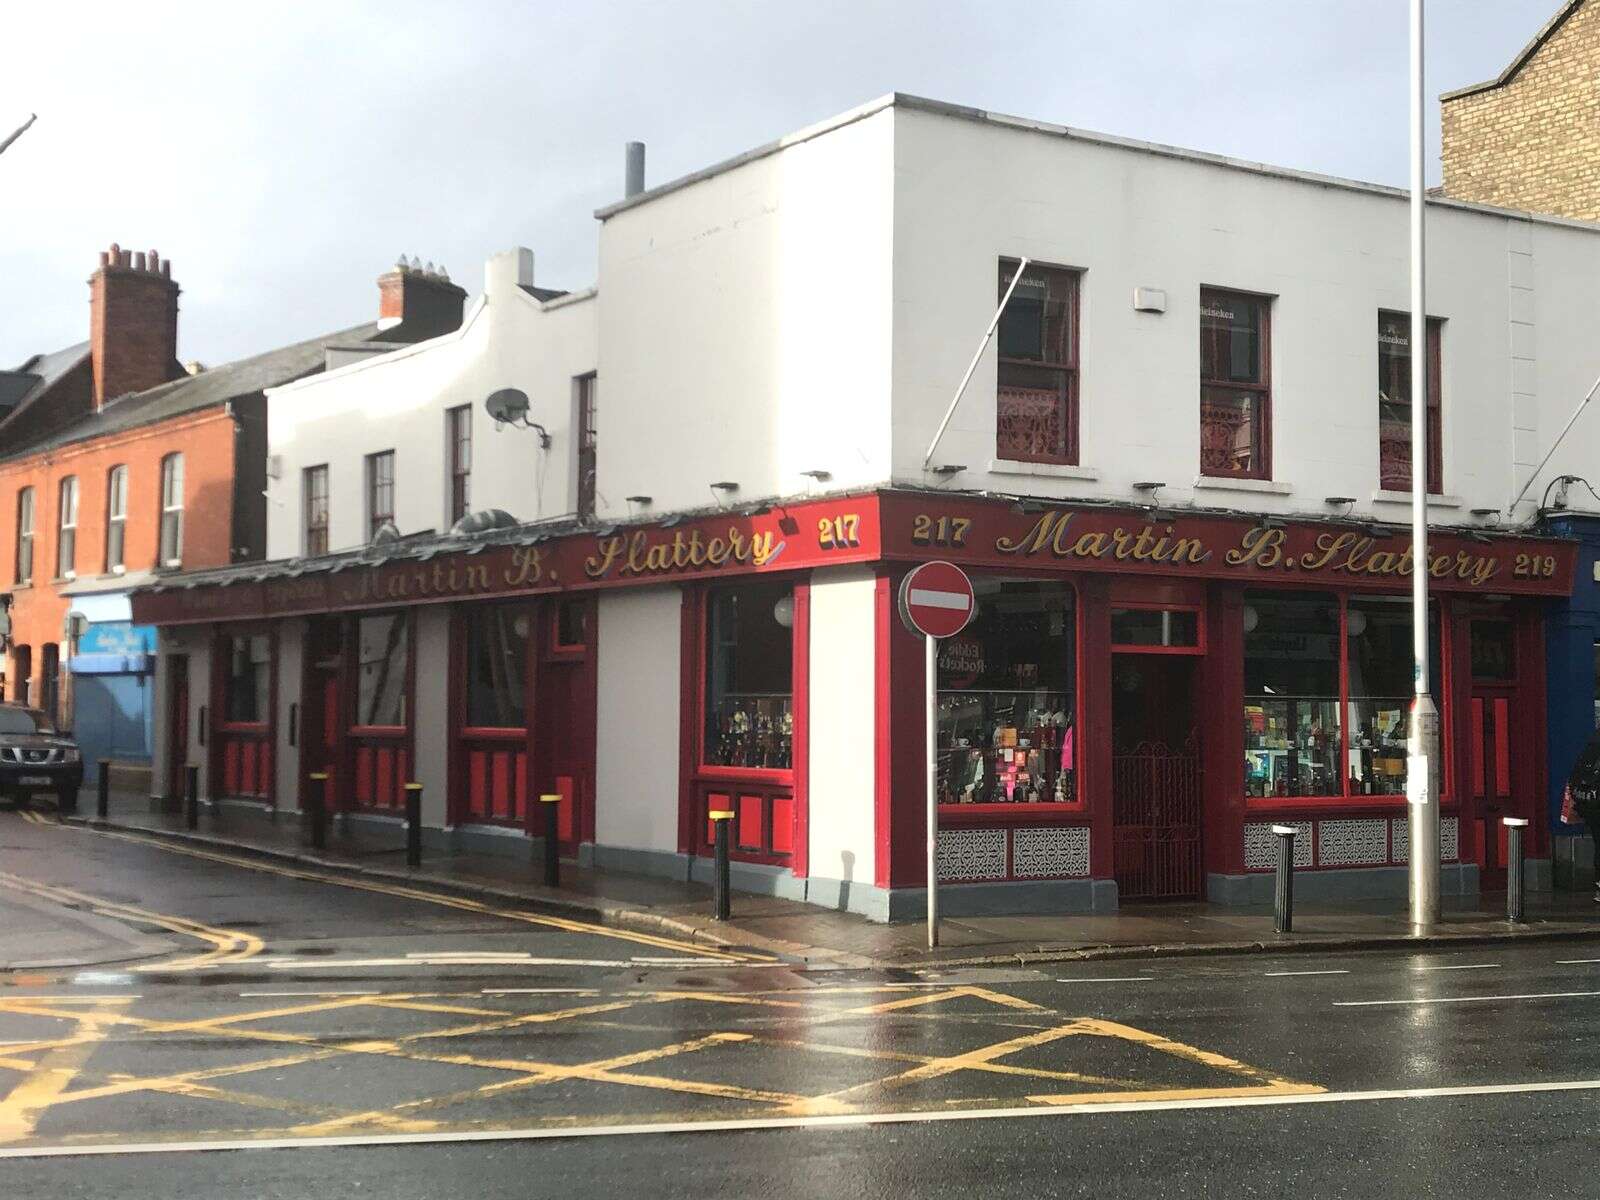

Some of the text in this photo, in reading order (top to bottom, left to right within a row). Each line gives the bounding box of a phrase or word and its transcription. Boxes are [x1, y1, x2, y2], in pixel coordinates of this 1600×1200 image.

[343, 559, 491, 600] Martin
[504, 547, 558, 585] B.
[585, 526, 785, 577] Slattery
[818, 514, 861, 549] 217
[912, 514, 973, 546] 217
[996, 510, 1212, 565] Martin
[1226, 528, 1294, 568] B.
[1514, 552, 1557, 581] 219
